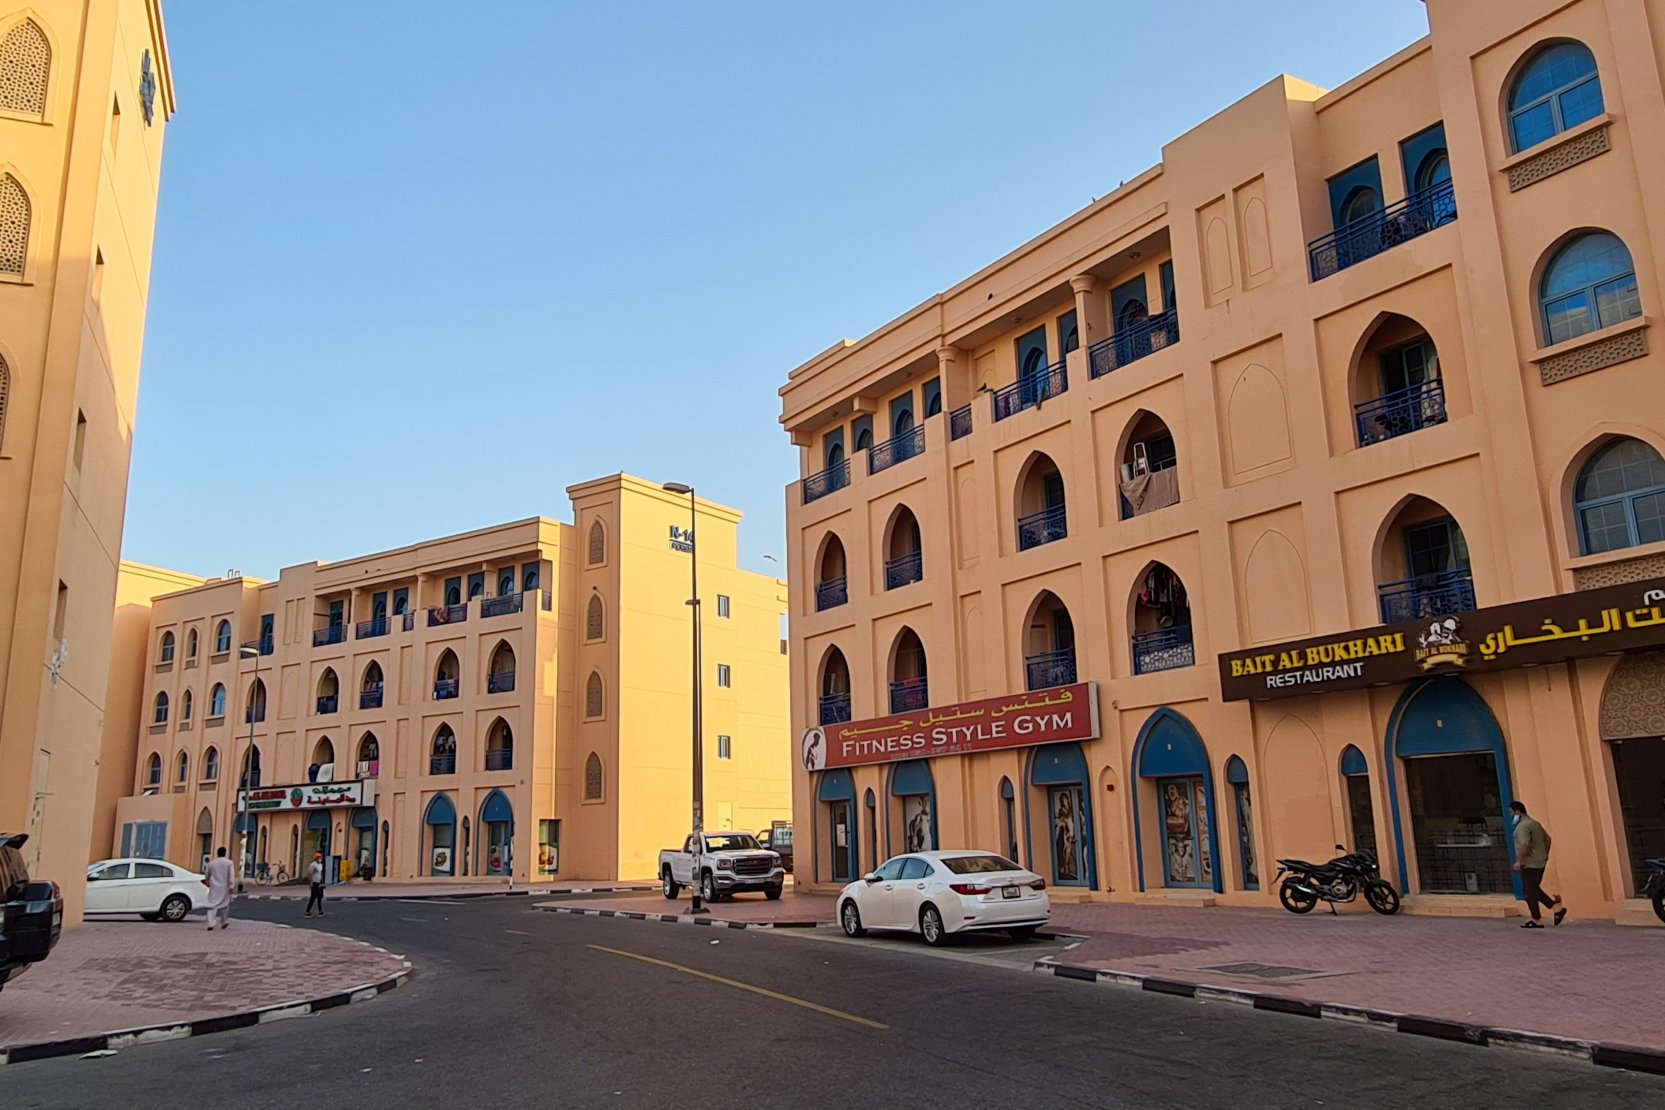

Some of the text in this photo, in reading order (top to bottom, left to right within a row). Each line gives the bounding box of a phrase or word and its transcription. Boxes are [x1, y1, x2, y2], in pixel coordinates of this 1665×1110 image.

[1479, 608, 1622, 660] البخاري
[1230, 632, 1406, 677] BAIT AL BUKHARI
[1266, 662, 1365, 688] RESTAURANT
[838, 719, 913, 741] جيم
[842, 733, 926, 757] FITNESS
[932, 721, 1006, 745] STYLE
[1013, 712, 1073, 734] GYM
[919, 706, 984, 728] ستيل
